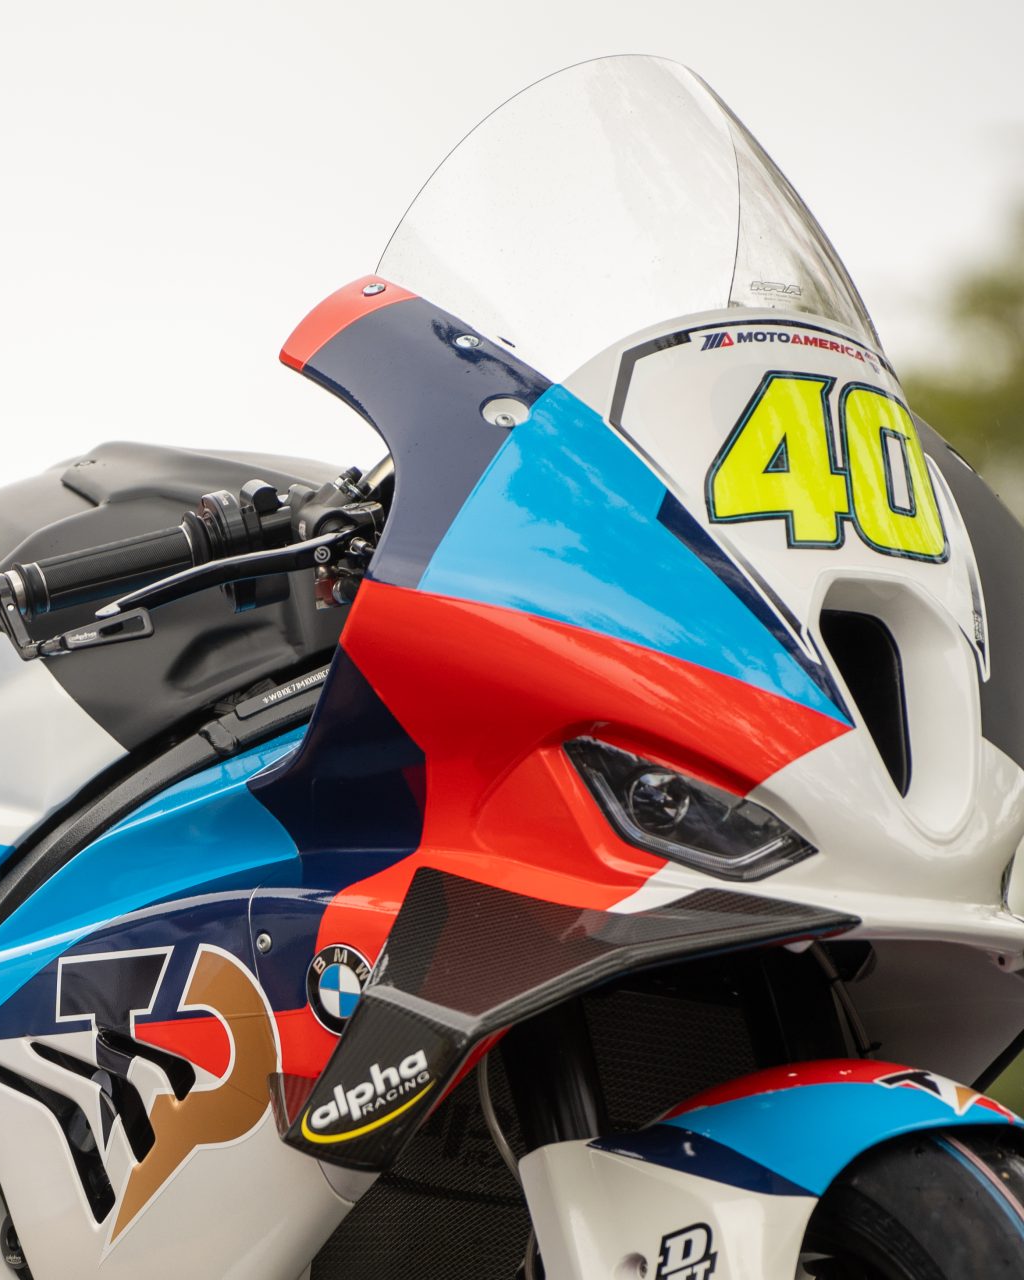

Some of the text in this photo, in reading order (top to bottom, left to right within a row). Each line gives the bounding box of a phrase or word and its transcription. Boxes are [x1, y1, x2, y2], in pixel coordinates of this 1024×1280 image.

[736, 331, 866, 363] MOTOAMERICA
[704, 369, 951, 564] 40
[312, 948, 370, 981] BMW
[310, 1049, 428, 1129] alpha
[361, 1070, 430, 1116] RACING
